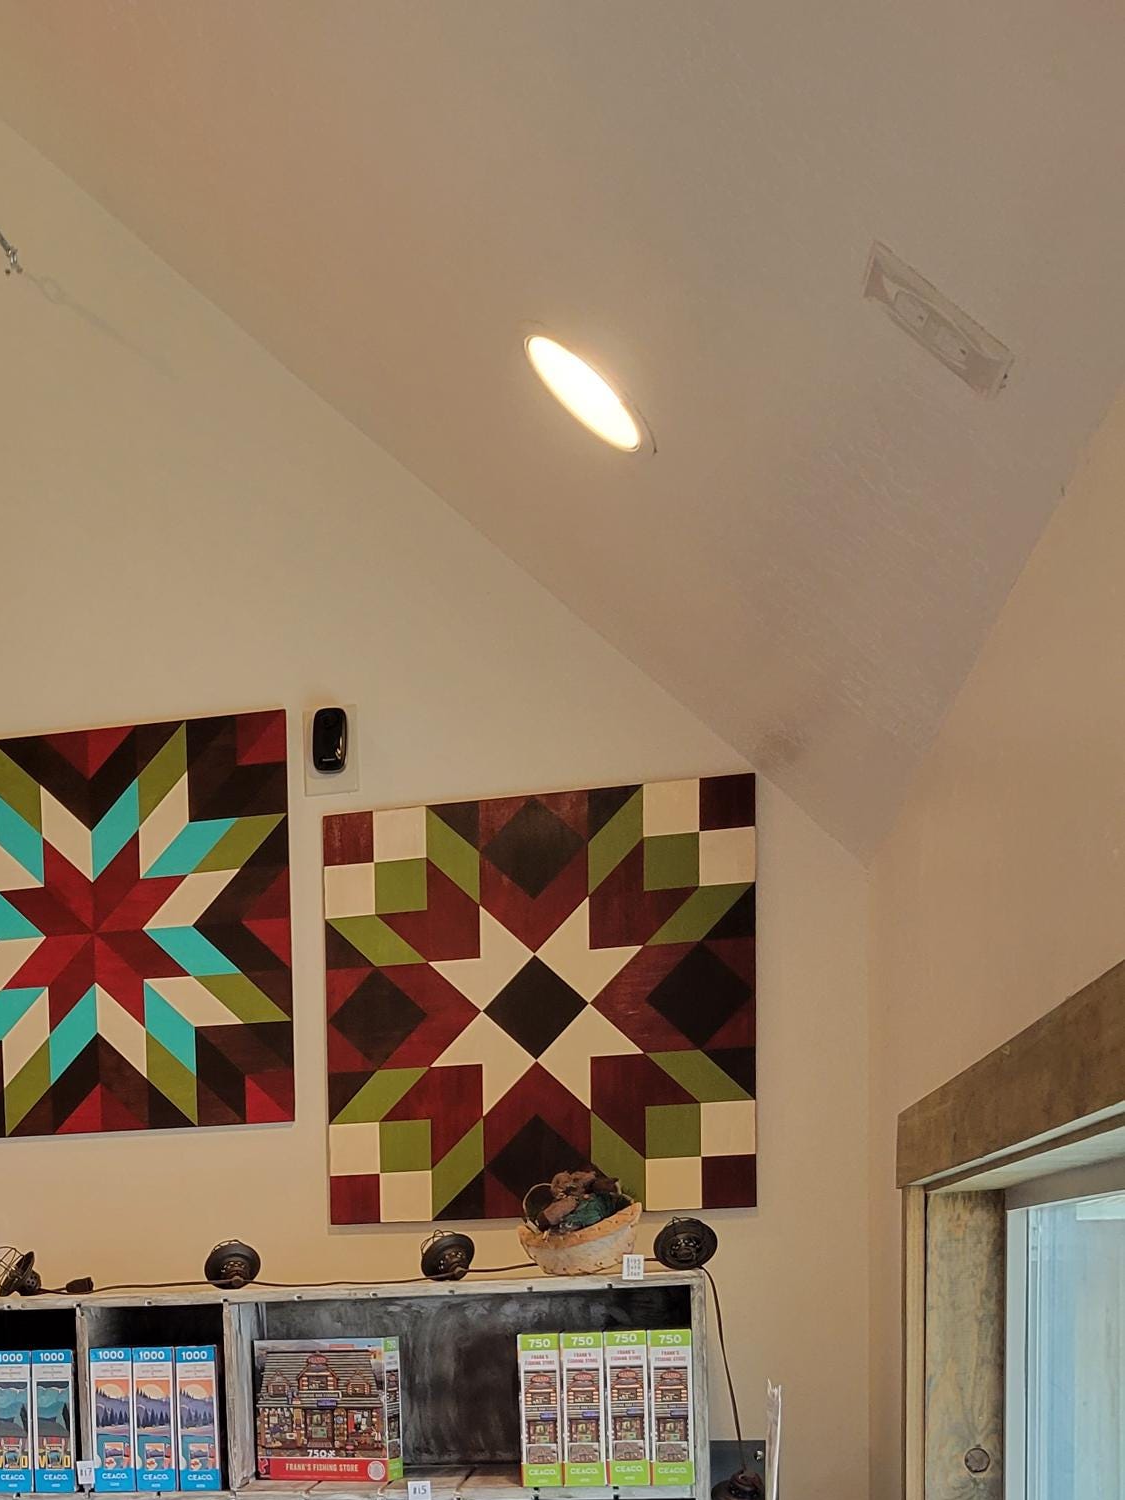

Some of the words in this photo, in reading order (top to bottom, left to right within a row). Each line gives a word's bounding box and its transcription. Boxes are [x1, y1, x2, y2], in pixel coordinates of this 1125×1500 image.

[528, 1338, 551, 1348] 750
[571, 1336, 594, 1346] 750
[614, 1334, 637, 1343] 750
[659, 1334, 682, 1344] 750
[40, 1352, 65, 1362] 1000
[98, 1350, 125, 1360] 1000
[139, 1350, 165, 1360] 1000
[181, 1350, 207, 1360] 1000
[307, 1449, 326, 1458] 750
[285, 1463, 310, 1472] FRANK'S
[312, 1463, 337, 1472] FISHING
[339, 1463, 359, 1472] STORE
